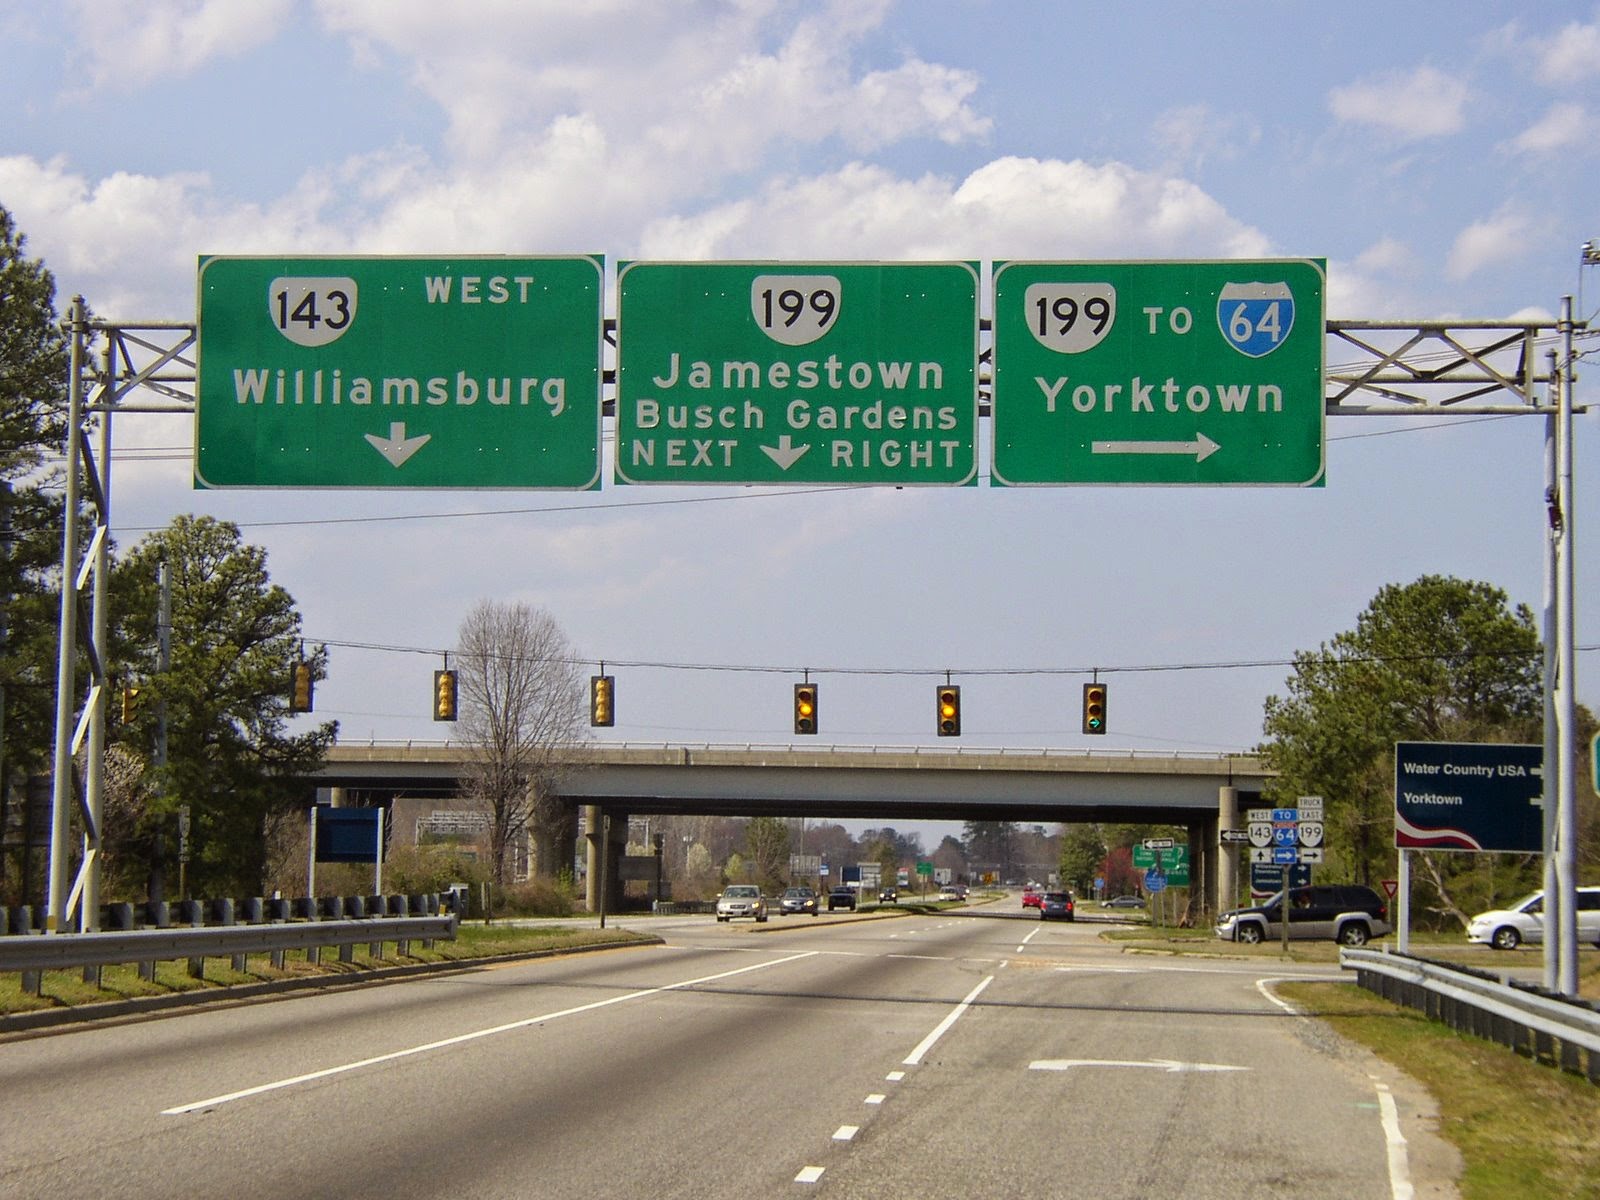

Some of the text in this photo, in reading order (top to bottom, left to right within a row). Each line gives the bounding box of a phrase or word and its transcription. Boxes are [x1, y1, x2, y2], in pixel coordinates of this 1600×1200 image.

[425, 276, 534, 304] WEST
[277, 290, 350, 330] 143
[761, 289, 836, 328] 199
[1036, 297, 1281, 343] 199 TO 64
[652, 353, 943, 390] Jamestown
[233, 369, 565, 417] Williamsburg
[1034, 376, 1282, 413] Yorktown
[636, 399, 957, 430] Busch Gardens
[632, 439, 959, 467] NEXT RIGHT
[1404, 762, 1526, 778] Water Country USA
[1300, 798, 1320, 807] TRUCK
[1404, 792, 1462, 805] Yorktown
[1251, 811, 1269, 819] WEST
[1278, 811, 1291, 819] TO
[1301, 811, 1320, 819] EAST
[1250, 826, 1271, 838] 143
[1276, 829, 1294, 841] 64
[1300, 826, 1321, 838] 199
